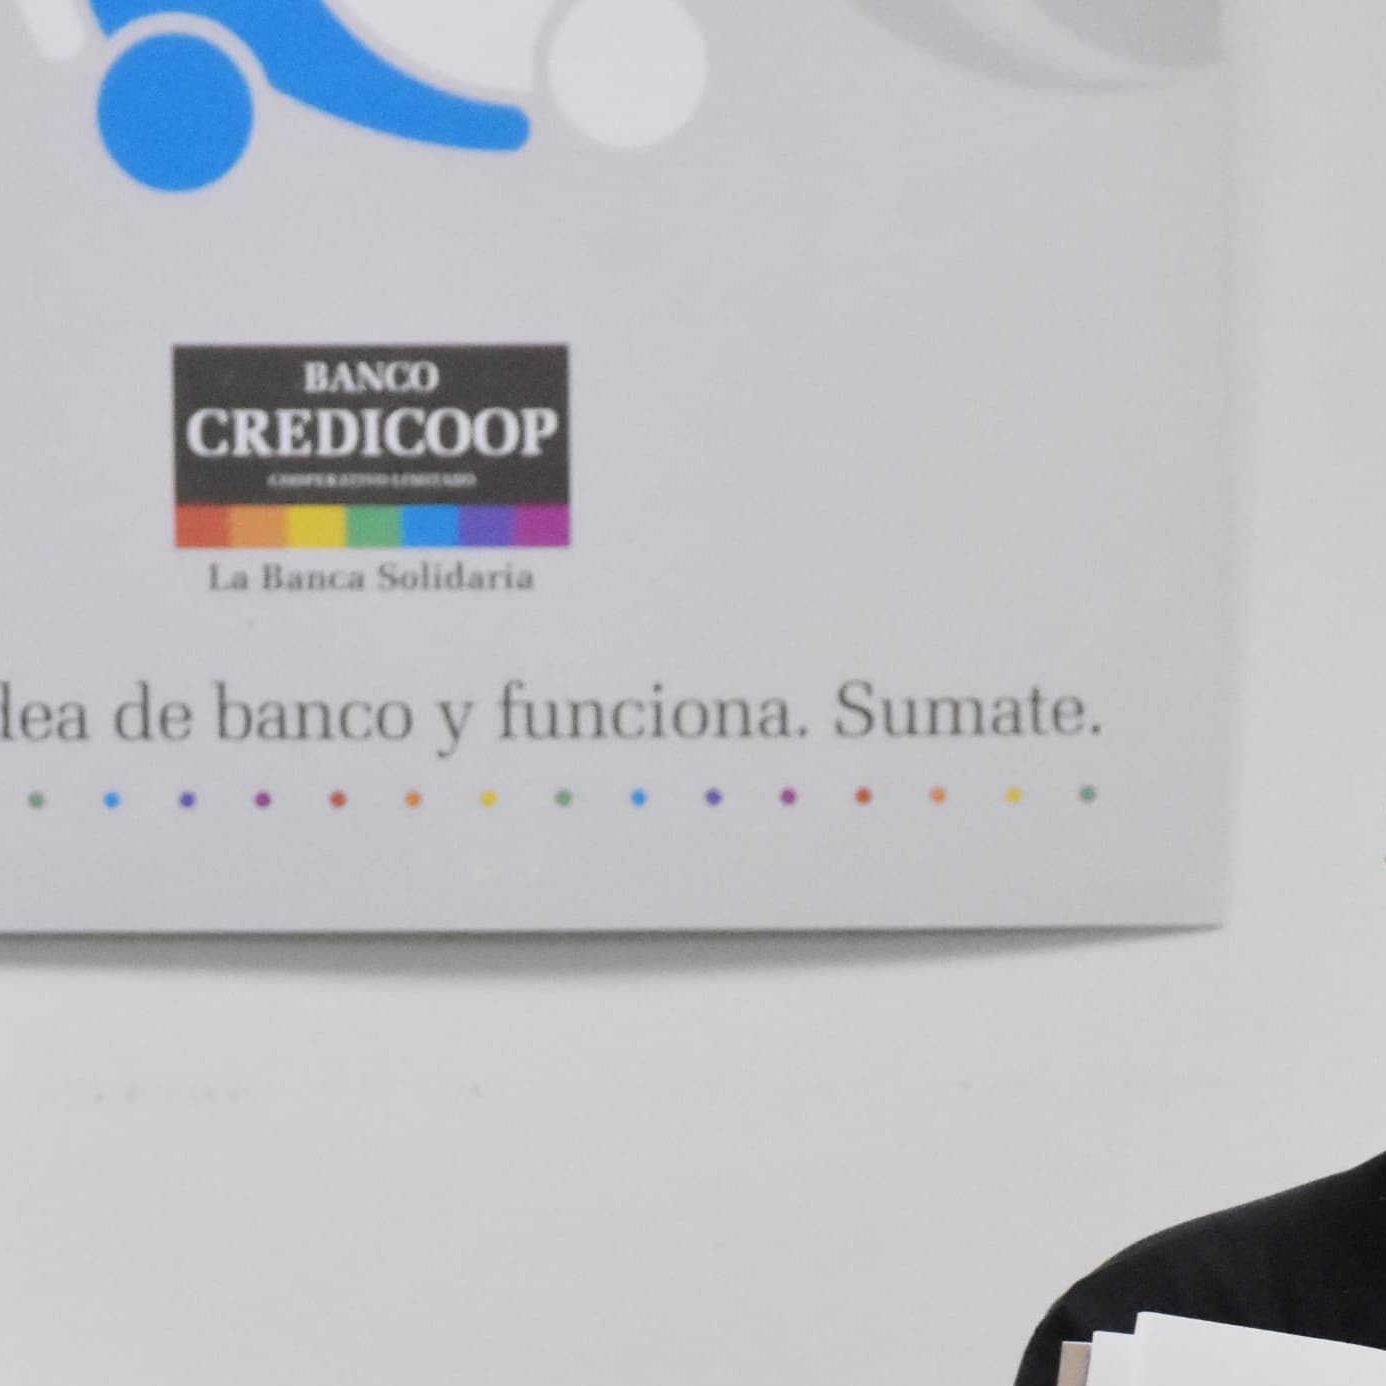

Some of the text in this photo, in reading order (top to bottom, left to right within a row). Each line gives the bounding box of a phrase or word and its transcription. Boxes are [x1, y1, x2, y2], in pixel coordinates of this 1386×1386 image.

[304, 361, 440, 394] BANCO
[185, 406, 559, 458] CREDICOOP
[210, 562, 535, 592] La Banca Solidaria
[114, 681, 192, 742] de
[212, 679, 415, 742] banco
[435, 699, 474, 760] y
[498, 679, 810, 742] funciona.
[834, 678, 1102, 738] Sumate.
